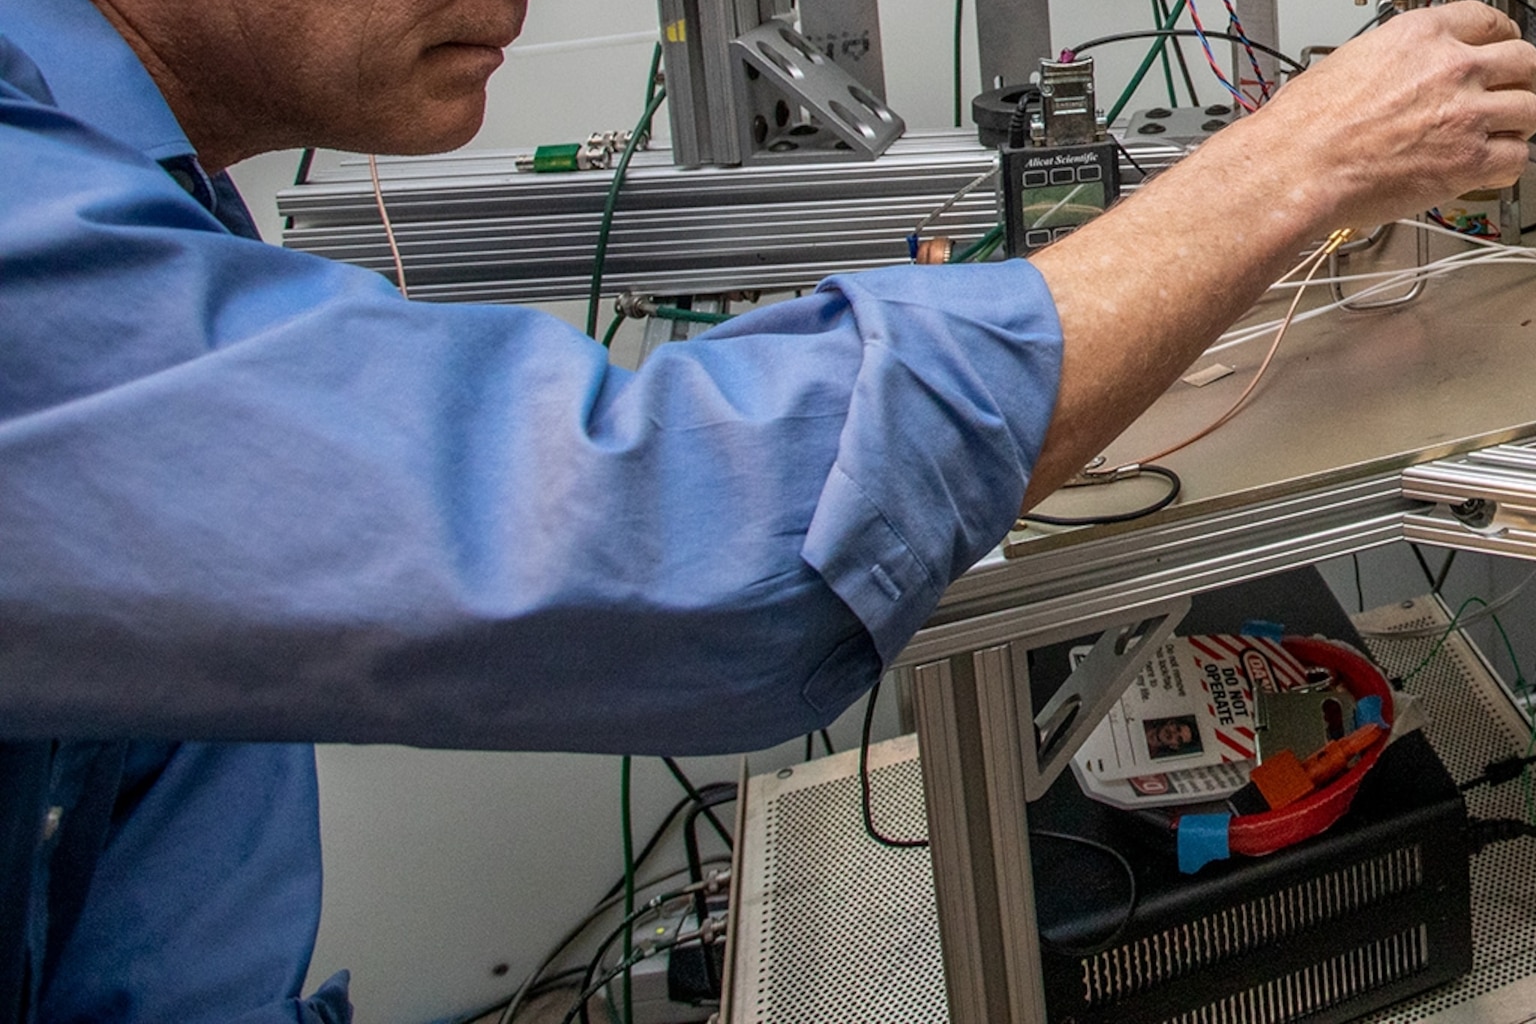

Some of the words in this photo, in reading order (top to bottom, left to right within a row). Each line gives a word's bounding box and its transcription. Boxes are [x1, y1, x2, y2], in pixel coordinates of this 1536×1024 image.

[1025, 157, 1053, 167] Alicat
[1054, 152, 1099, 166] Scientific
[1222, 668, 1239, 686] DO
[1203, 663, 1233, 725] OPERATE
[1229, 689, 1248, 719] NOT
